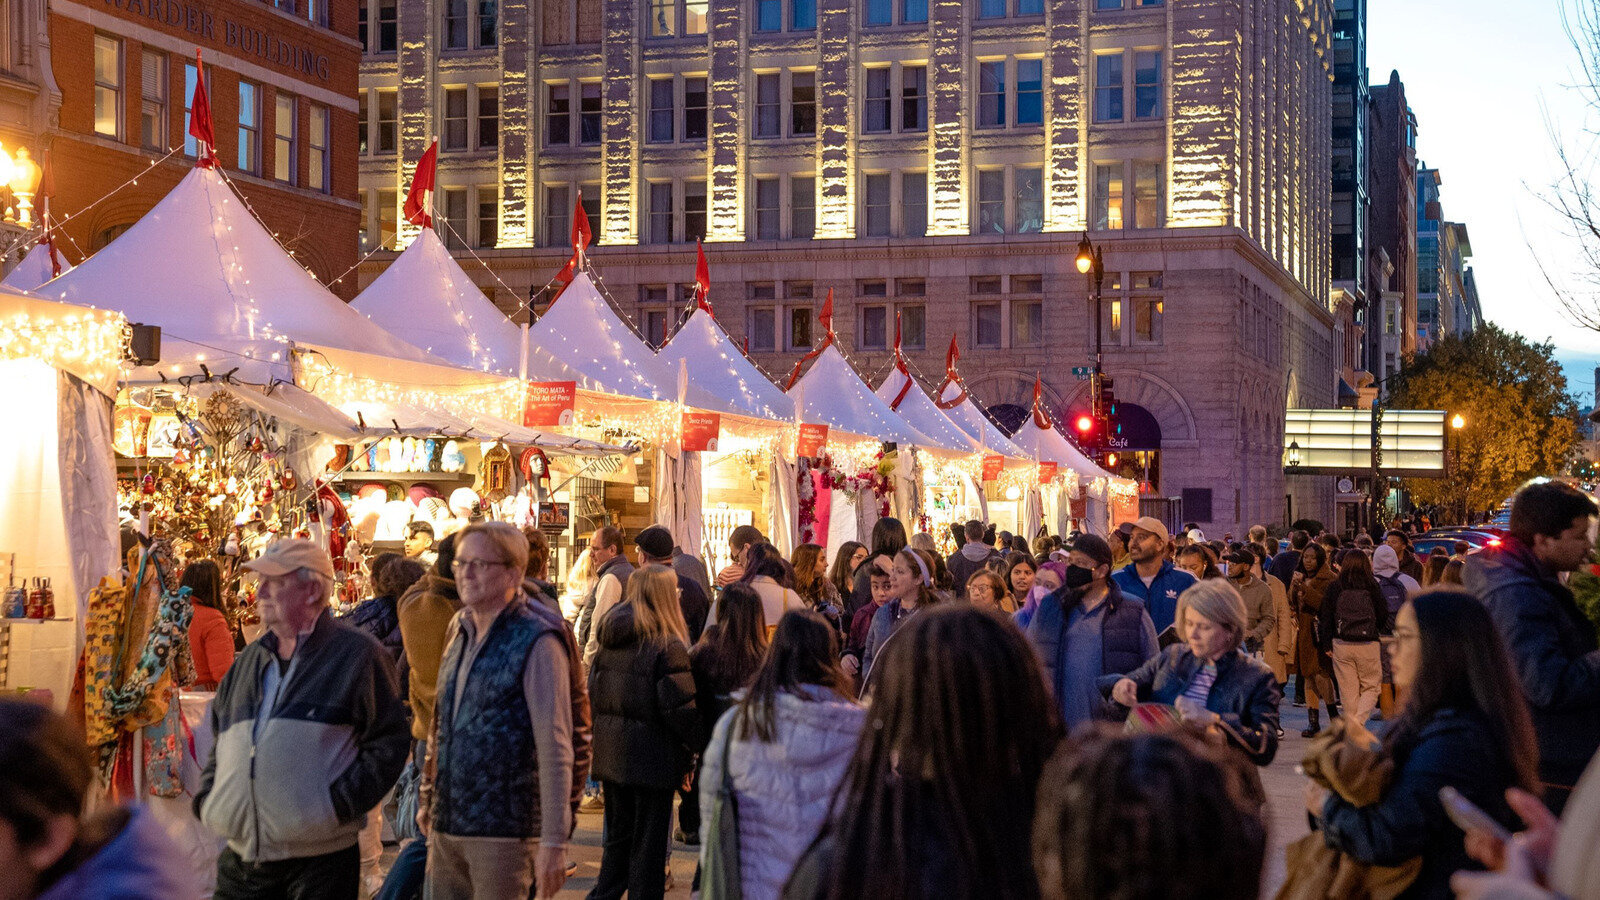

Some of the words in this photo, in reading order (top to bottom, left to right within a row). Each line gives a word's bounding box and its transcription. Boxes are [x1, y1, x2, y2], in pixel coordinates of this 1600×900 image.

[104, 0, 215, 40] ARDER
[225, 19, 330, 81] BUILDING
[533, 387, 550, 395] TORO
[550, 386, 566, 394] MATA
[531, 394, 541, 402] The
[542, 394, 550, 402] Art
[564, 414, 570, 424] 7
[1108, 437, 1129, 449] Café
